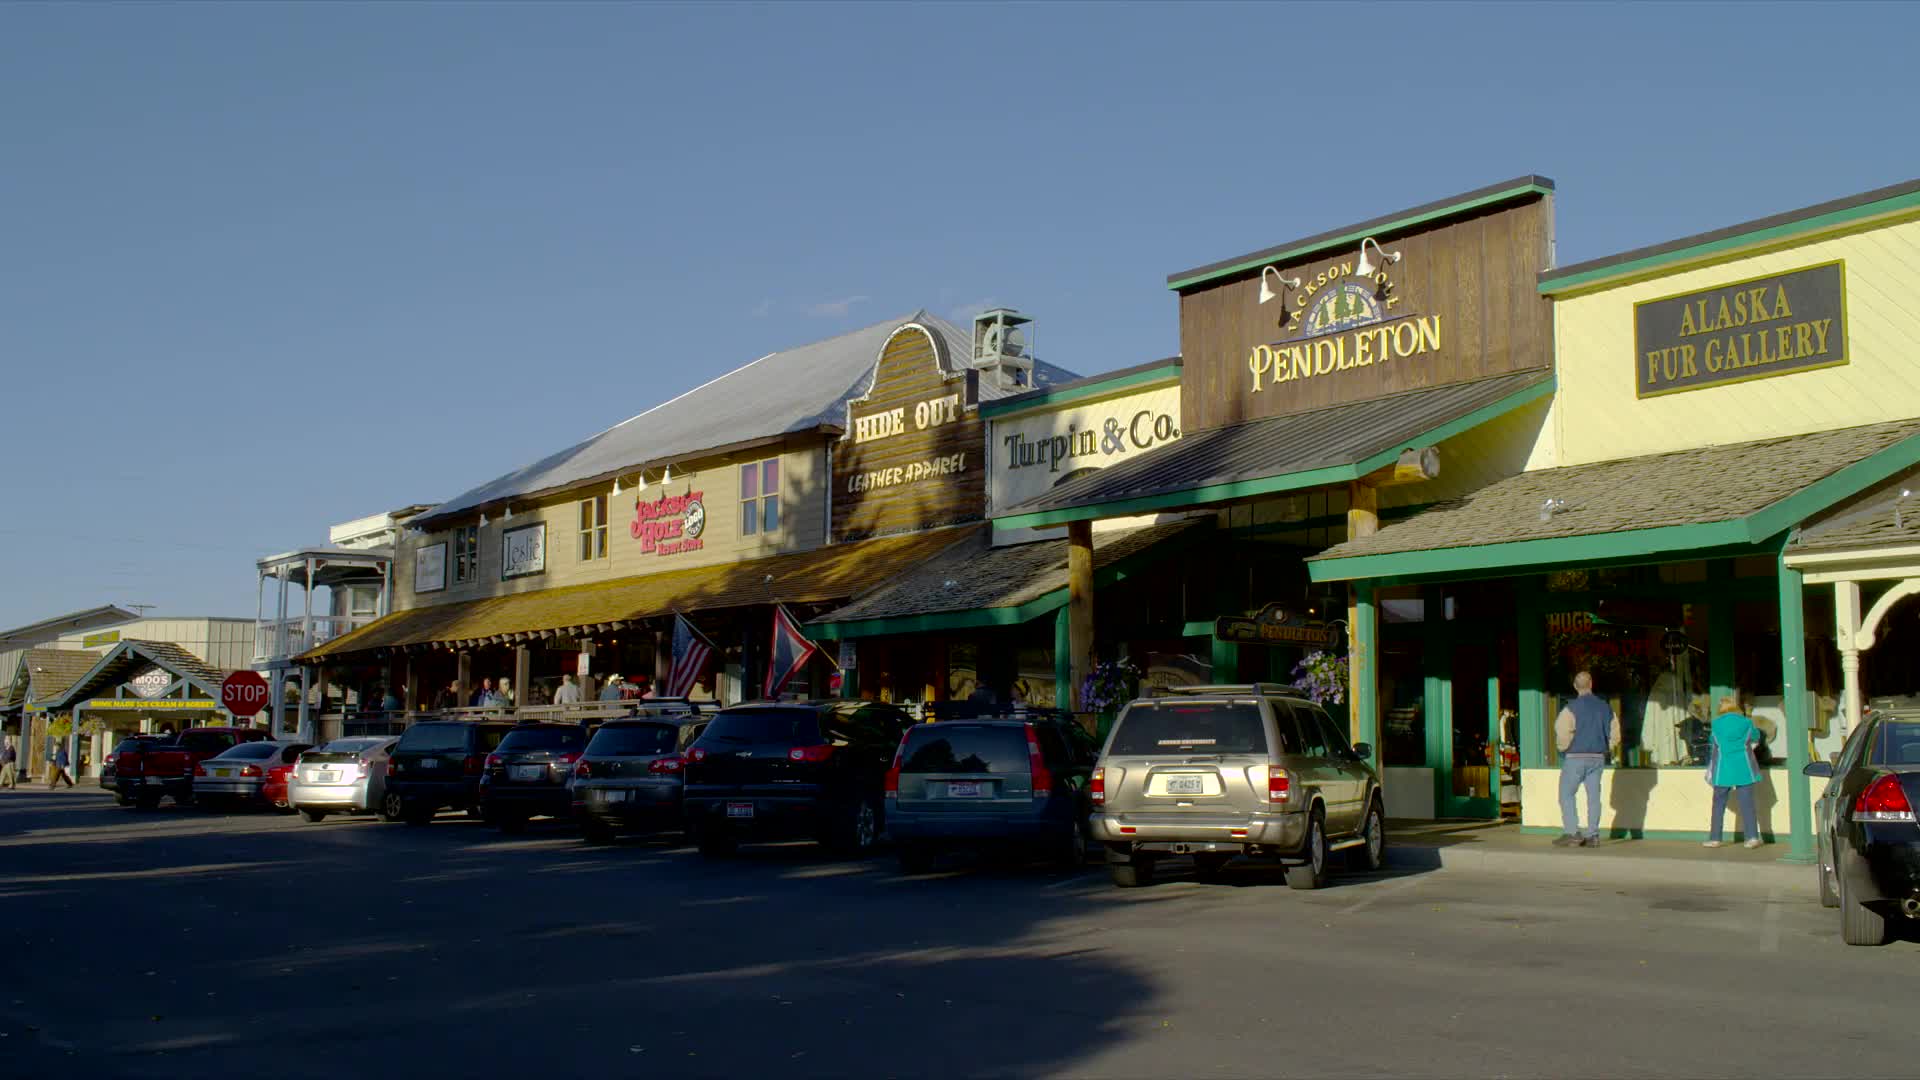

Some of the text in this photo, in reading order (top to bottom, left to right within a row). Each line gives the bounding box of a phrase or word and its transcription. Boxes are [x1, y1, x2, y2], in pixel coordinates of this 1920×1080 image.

[1288, 262, 1352, 332] JACKSON
[1680, 282, 1792, 337] ALASKA
[1249, 314, 1442, 392] PENDLETON
[1647, 319, 1832, 383] FUR GALLERY
[855, 394, 959, 444] HIDE OUT
[847, 452, 967, 493] LEATHER APPAREL
[641, 518, 684, 553] HOLE
[224, 684, 266, 702] STOP
